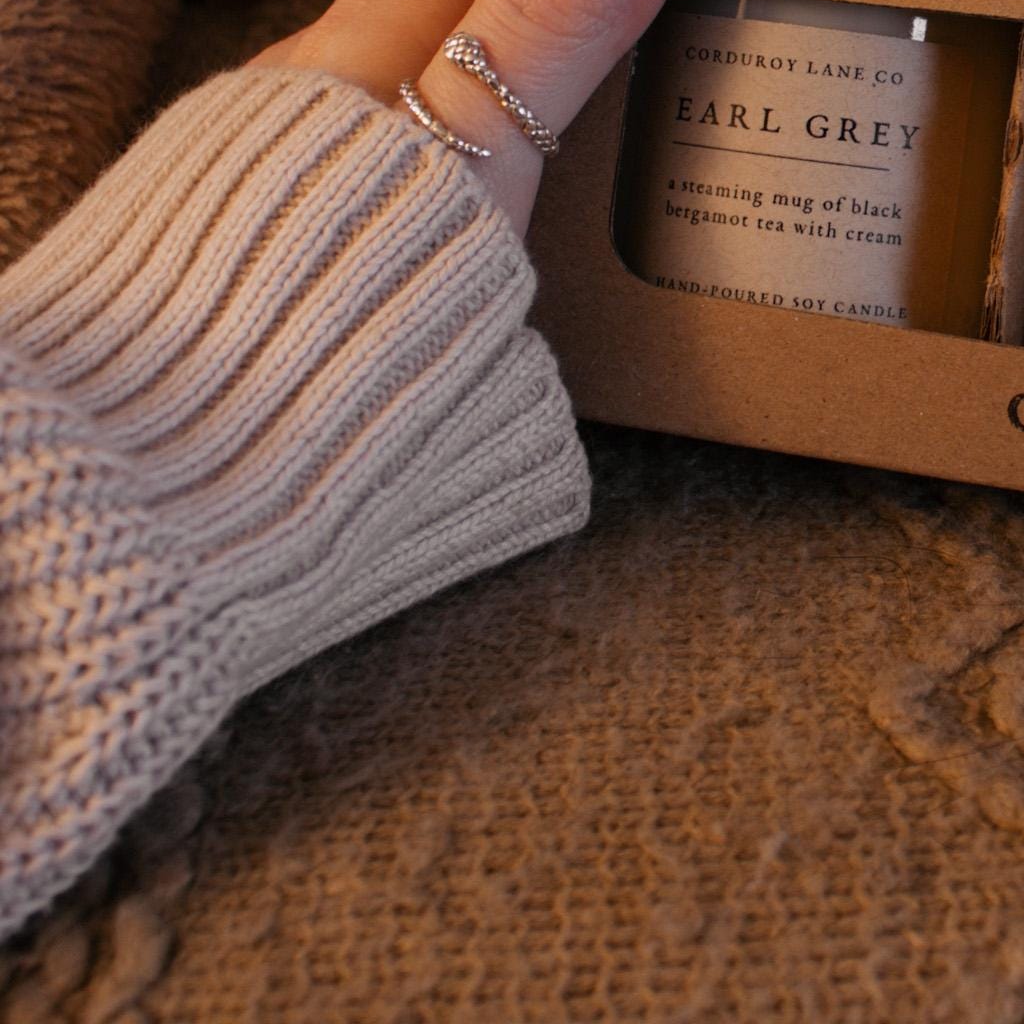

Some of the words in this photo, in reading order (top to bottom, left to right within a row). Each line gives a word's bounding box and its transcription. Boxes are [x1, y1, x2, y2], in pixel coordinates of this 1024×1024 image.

[686, 46, 798, 72] CORDUROY
[807, 60, 865, 81] LANE
[875, 70, 903, 85] CO
[676, 97, 781, 133] EARL
[806, 115, 921, 150] GREY
[668, 178, 675, 190] a
[681, 180, 763, 207] steaming
[772, 194, 813, 214] mug
[823, 196, 846, 212] of
[852, 199, 902, 219] black
[665, 200, 748, 225] bergamot
[757, 218, 784, 232] tea
[794, 221, 837, 238] with
[846, 230, 902, 245] cream
[793, 297, 826, 311] SOY
[834, 301, 908, 319] CANDLE
